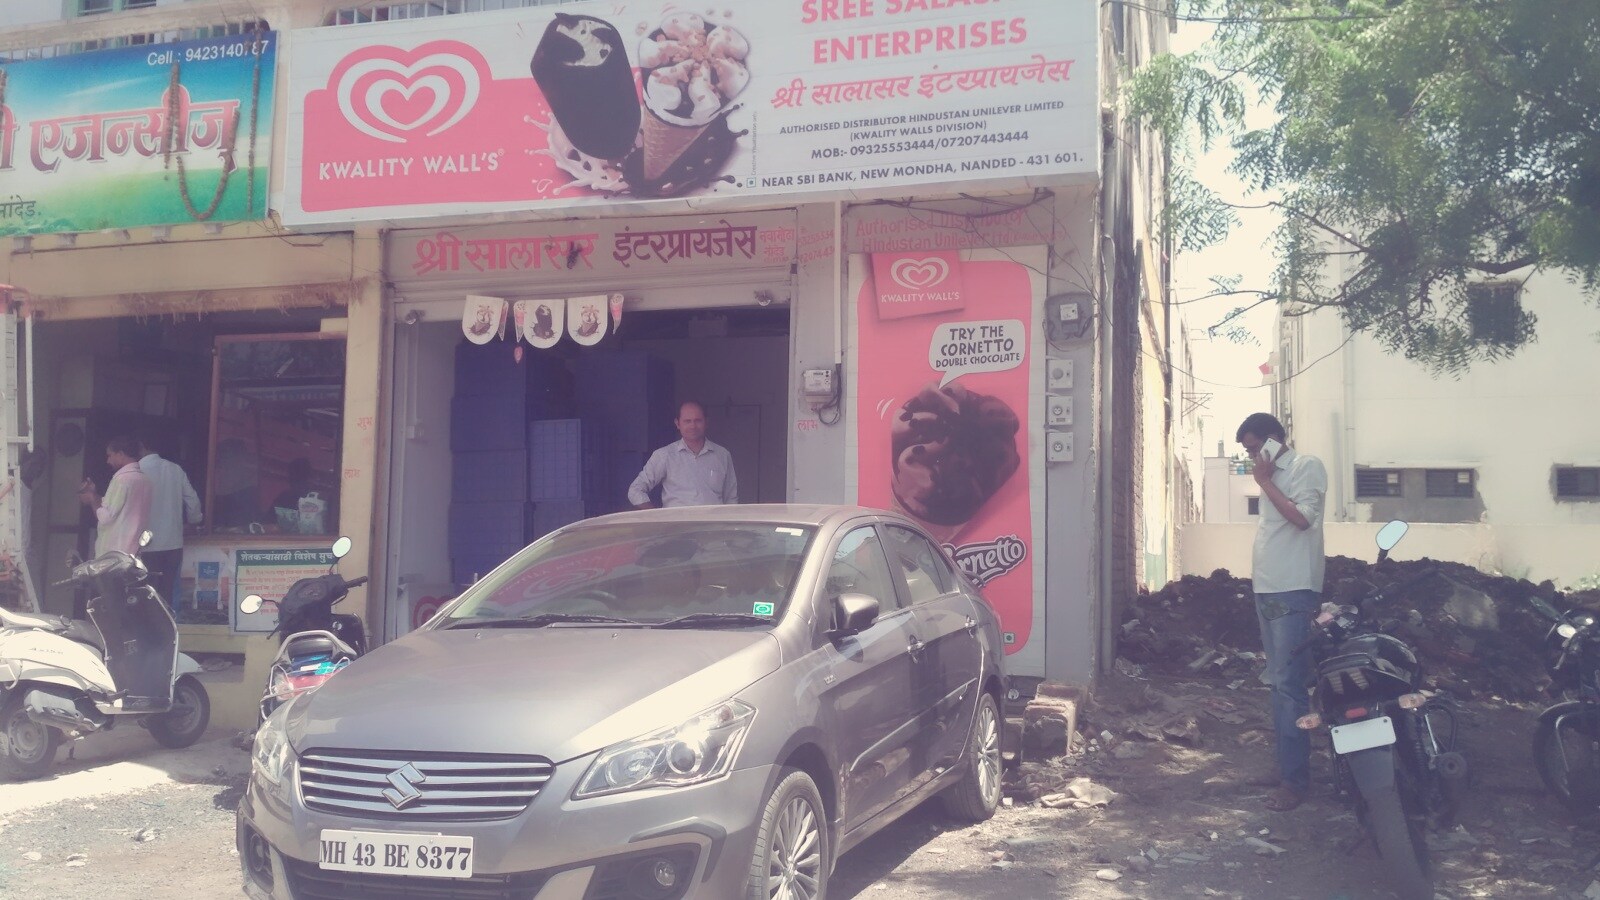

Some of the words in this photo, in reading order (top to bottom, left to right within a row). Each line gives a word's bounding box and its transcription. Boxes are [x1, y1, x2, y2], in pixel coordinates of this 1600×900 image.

[147, 52, 173, 66] Cell
[185, 40, 269, 62] 942314087
[813, 17, 1027, 64] ENTERPRISES
[770, 78, 806, 109] श्री
[811, 75, 914, 105] सालासर
[780, 121, 841, 134] AUTHORISED
[842, 115, 906, 129] DISTRIBUTOR
[909, 109, 969, 123] HINDUSTAN
[973, 104, 1021, 117] UNILEVER
[1025, 100, 1064, 112] LIMITED
[850, 129, 897, 143] (KWALITY
[900, 125, 933, 137] WALLS
[936, 120, 987, 134] DIVISION)
[319, 157, 414, 181] KWALITY
[762, 176, 793, 188] NEAR
[797, 174, 815, 185] SBI
[818, 171, 857, 184] BANK,
[861, 168, 890, 180] NEW
[893, 163, 957, 178] MONDHA,
[961, 157, 1016, 172] NANDED
[1027, 154, 1050, 166] 431
[412, 230, 463, 276] श्री
[465, 233, 599, 272] सालासर
[613, 219, 757, 268] इंटरप्रायजेस
[881, 293, 925, 303] KWALITY
[927, 291, 960, 302] WALL'S
[940, 338, 1014, 356] CORNETTO
[950, 327, 975, 341] TRY
[980, 325, 1004, 338] THE
[935, 357, 967, 368] DOUBLE
[970, 352, 1020, 365] CHOCOLATE
[944, 540, 1023, 574] rnetto
[319, 840, 347, 865] MH
[352, 843, 376, 866] 43
[384, 843, 410, 868] BE
[416, 845, 472, 871] 8377
